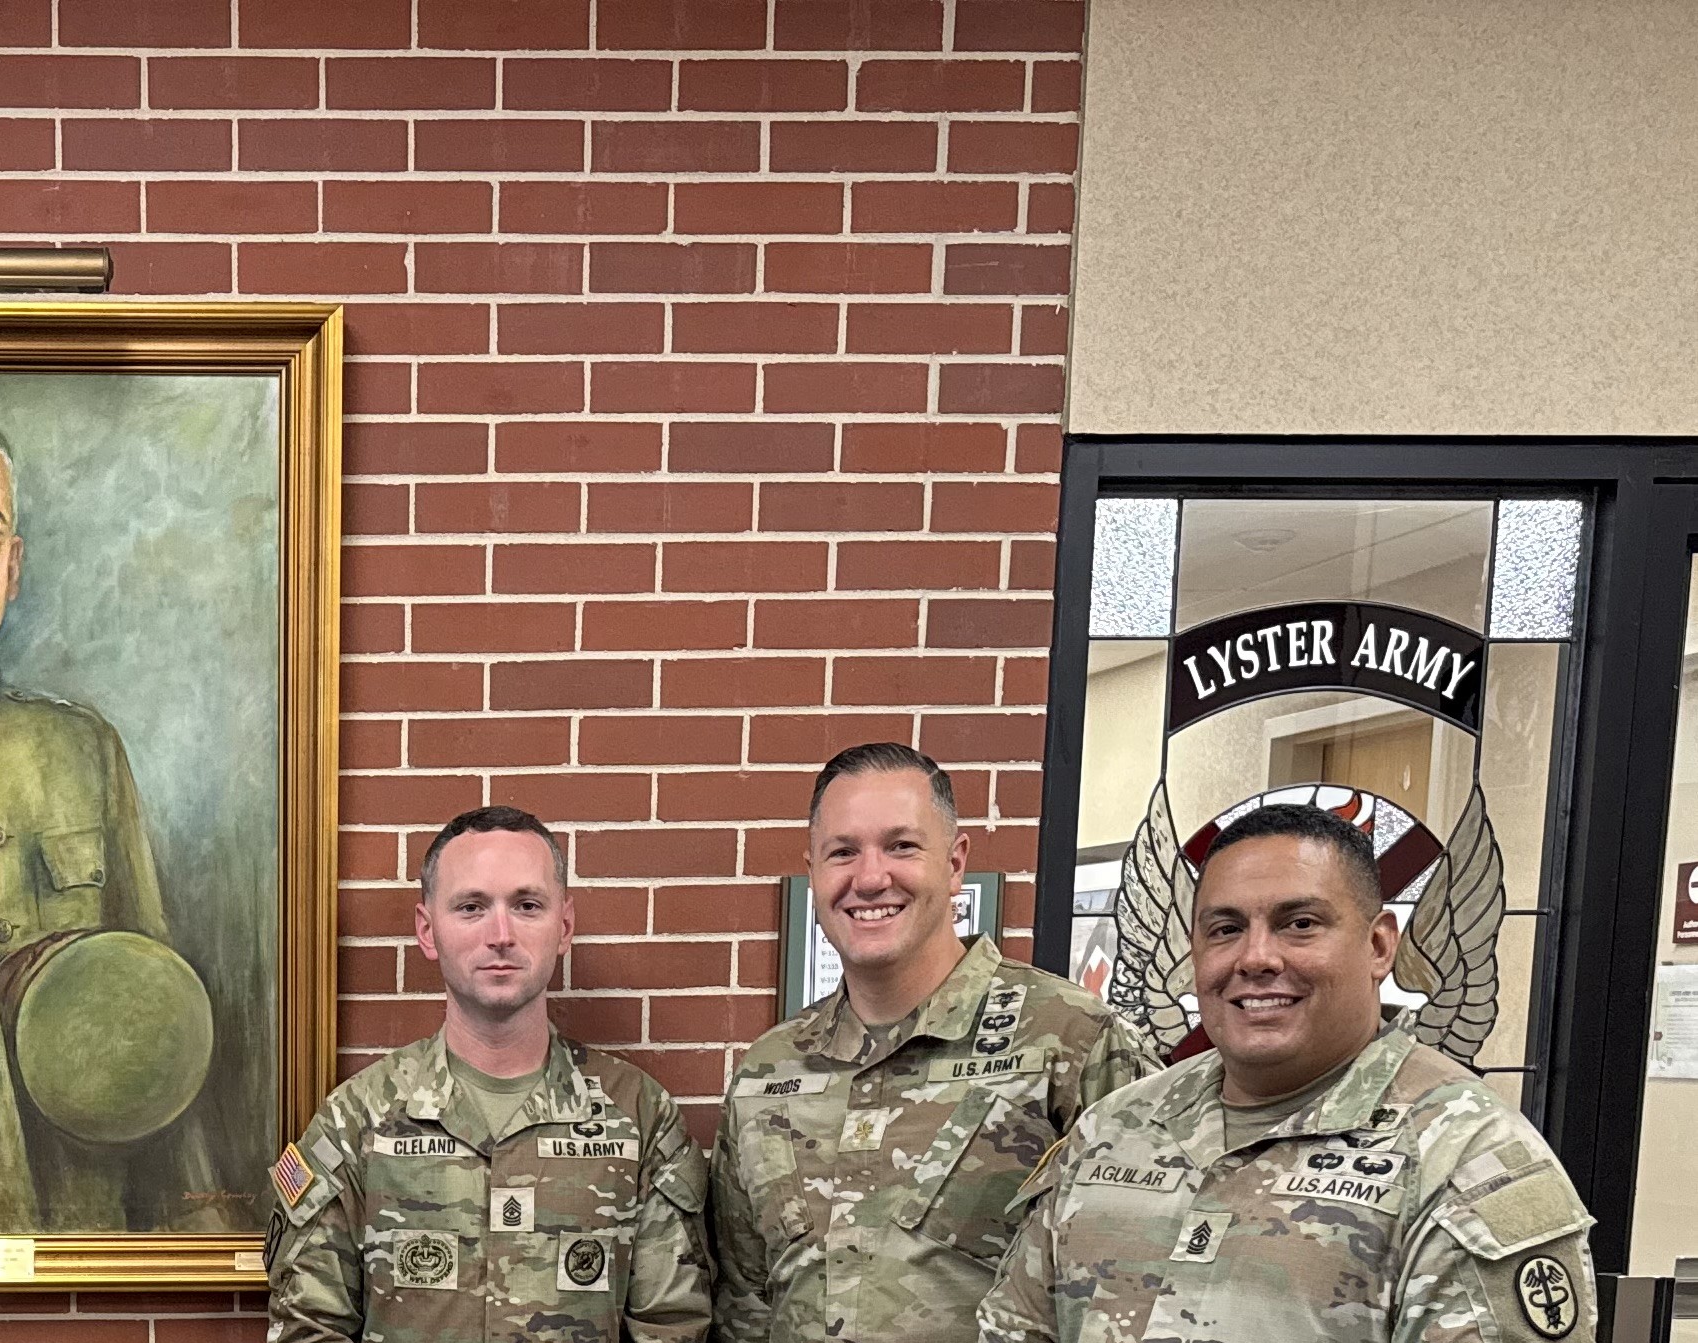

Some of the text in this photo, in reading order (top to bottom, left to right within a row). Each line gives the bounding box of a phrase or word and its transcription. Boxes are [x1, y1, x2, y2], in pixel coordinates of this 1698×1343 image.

[1183, 620, 1475, 700] LYSTER ARMY
[763, 1078, 802, 1095] WOODS
[394, 1138, 456, 1156] CLELAND
[1088, 1164, 1167, 1187] AGUILAR
